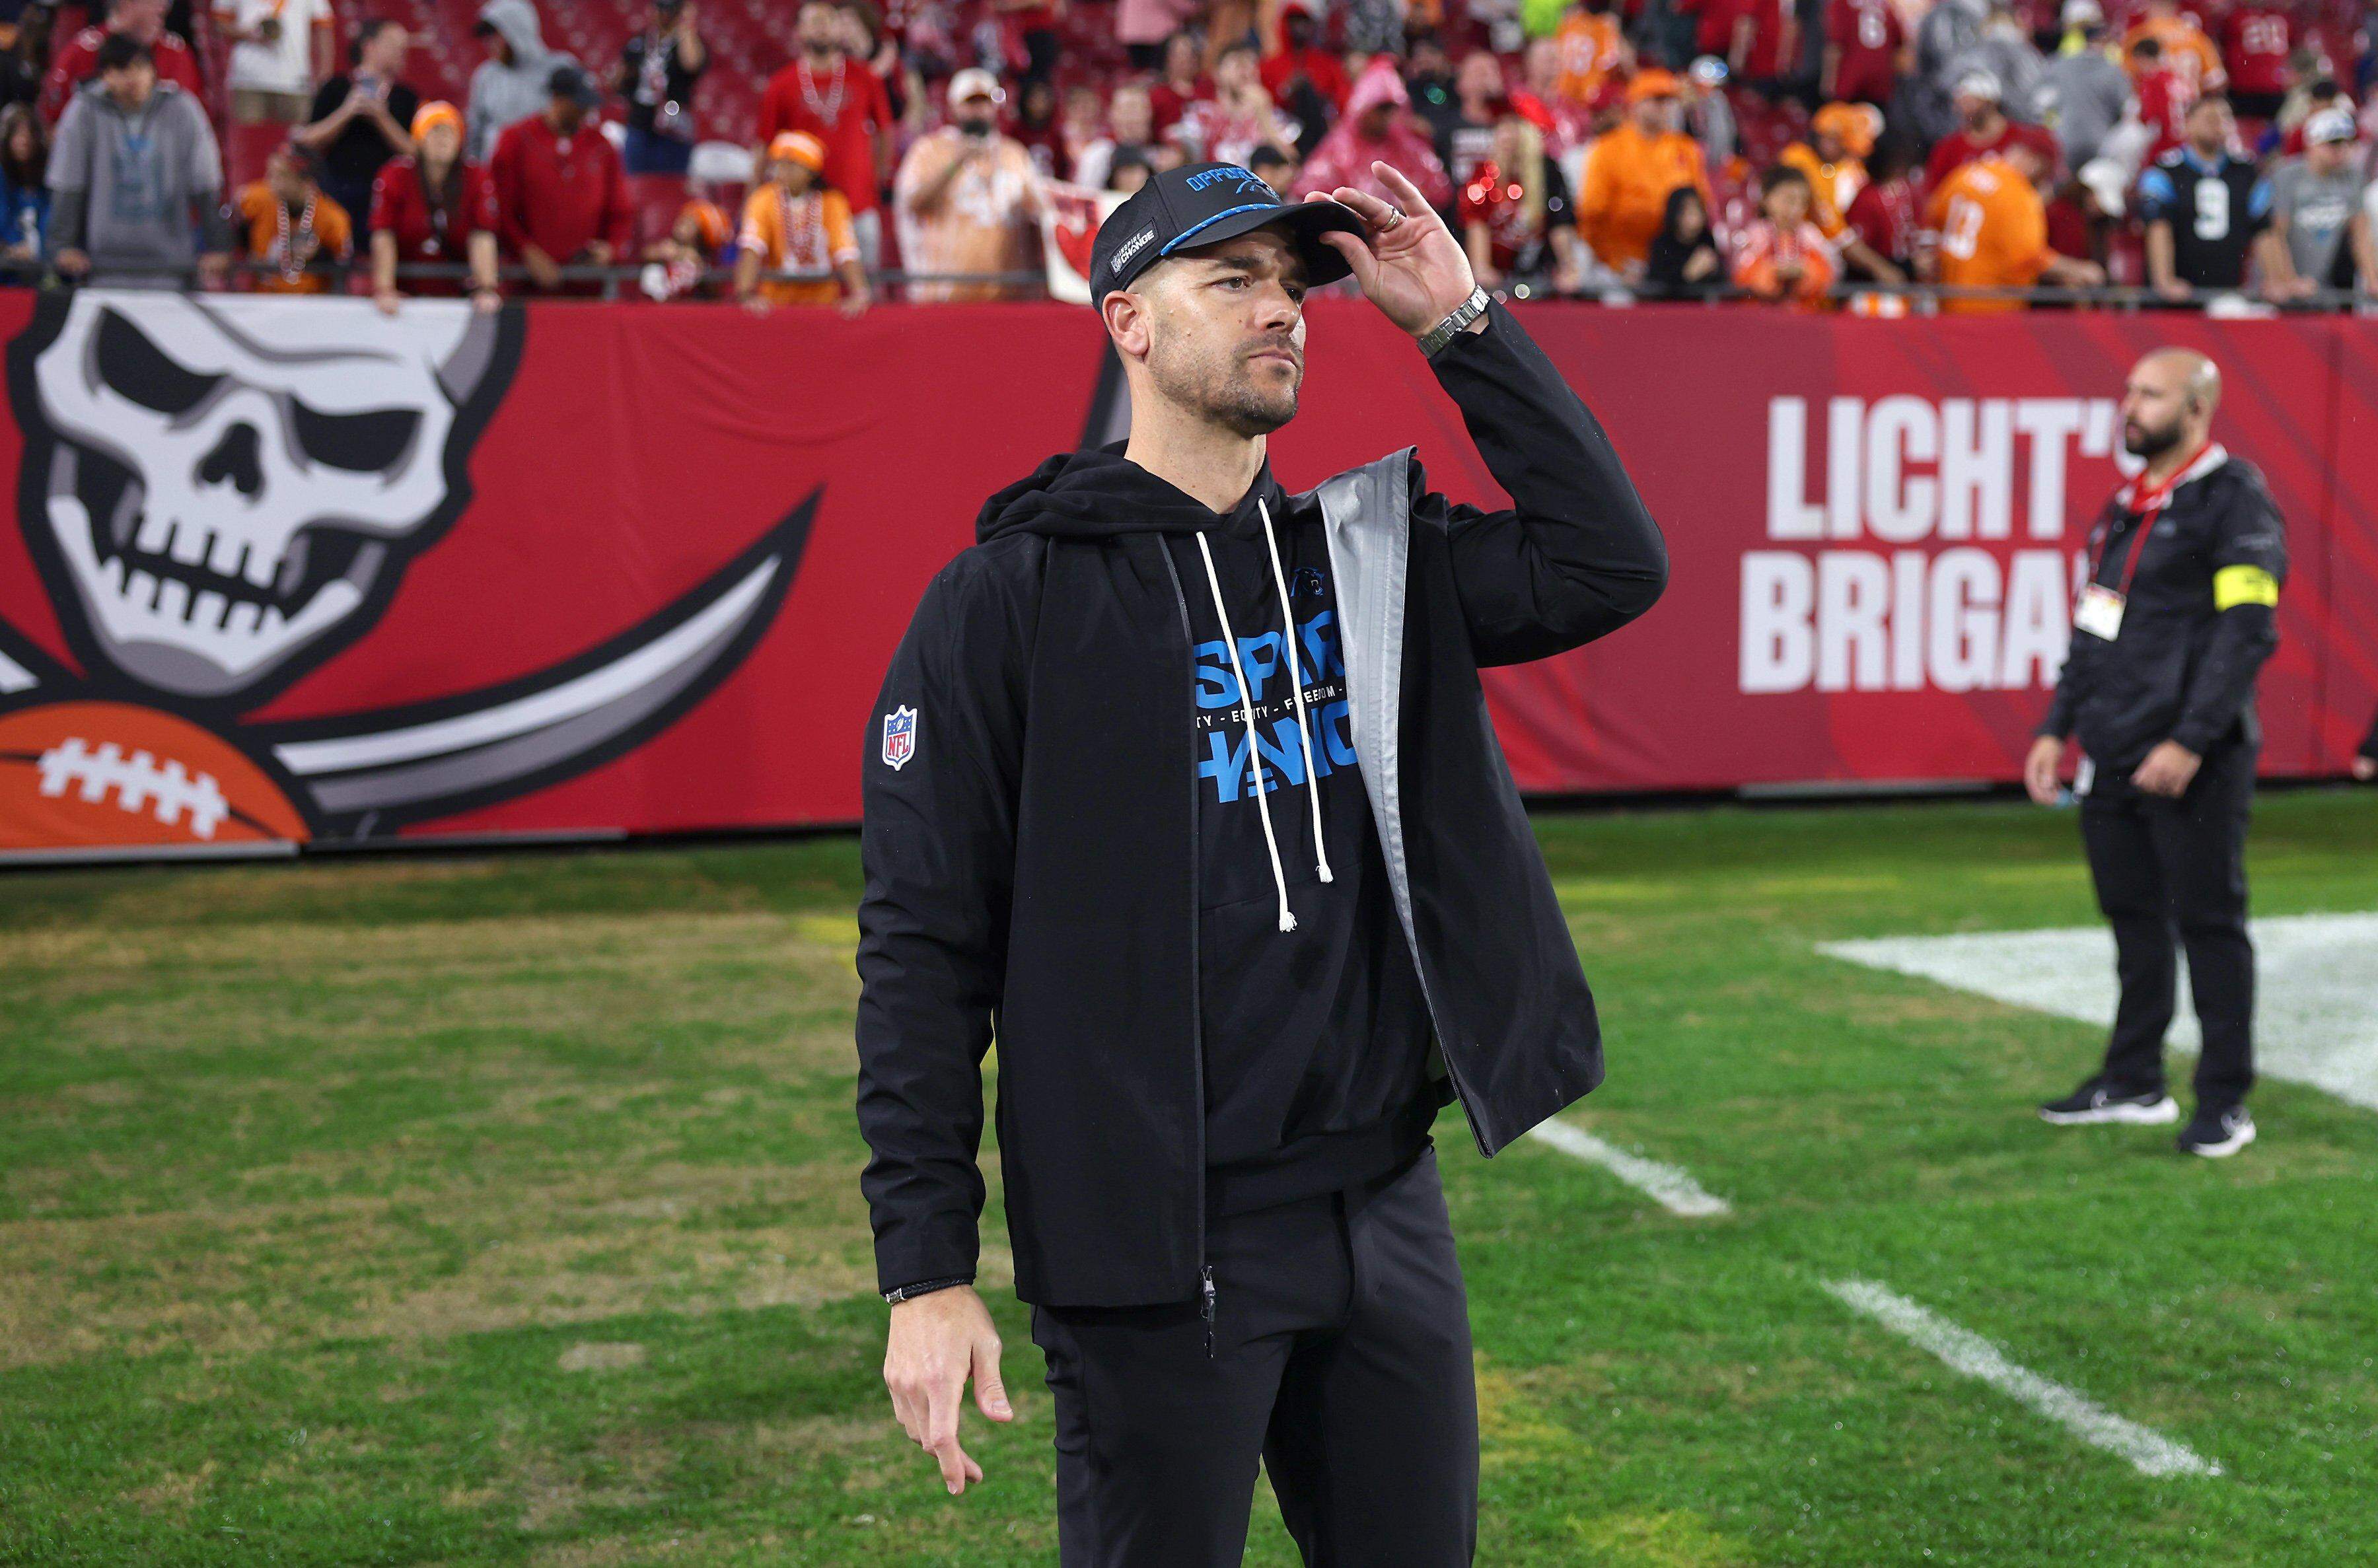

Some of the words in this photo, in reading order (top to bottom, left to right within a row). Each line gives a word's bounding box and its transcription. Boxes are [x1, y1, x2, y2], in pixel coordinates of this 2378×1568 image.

[2194, 178, 2230, 240] 9
[1118, 232, 1141, 256] INSPIRE
[1120, 230, 1155, 264] CHANGE
[1767, 394, 2146, 542] LICHT'
[1739, 548, 2089, 694] BRIGA
[1231, 705, 1268, 723] EQITY
[1283, 686, 1336, 710] FEEOM
[888, 733, 909, 758] NFL
